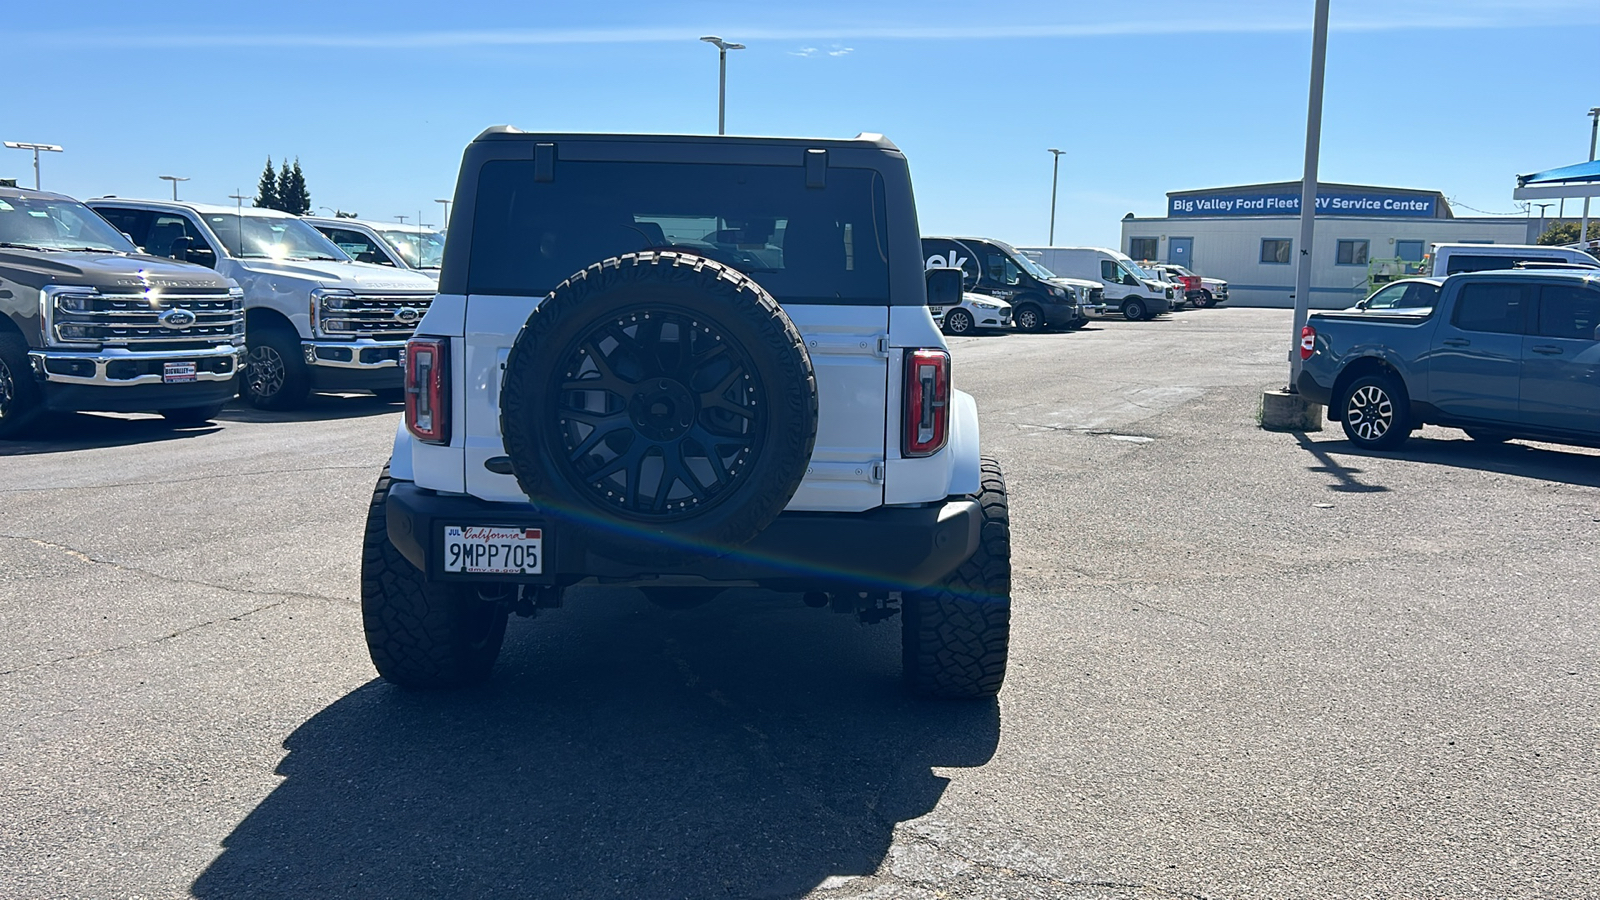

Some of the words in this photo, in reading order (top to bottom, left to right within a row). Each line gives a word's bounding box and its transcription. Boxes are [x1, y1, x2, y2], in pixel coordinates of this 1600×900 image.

[1173, 200, 1193, 212] Big
[1196, 199, 1234, 211] Valley
[1236, 198, 1264, 209] Ford
[1267, 198, 1299, 209] Fleet
[1332, 198, 1381, 210] Service
[1384, 199, 1429, 211] Center
[923, 250, 969, 278] ek
[170, 314, 188, 324] Ford
[464, 527, 525, 543] California
[449, 543, 537, 568] 9MPP705
